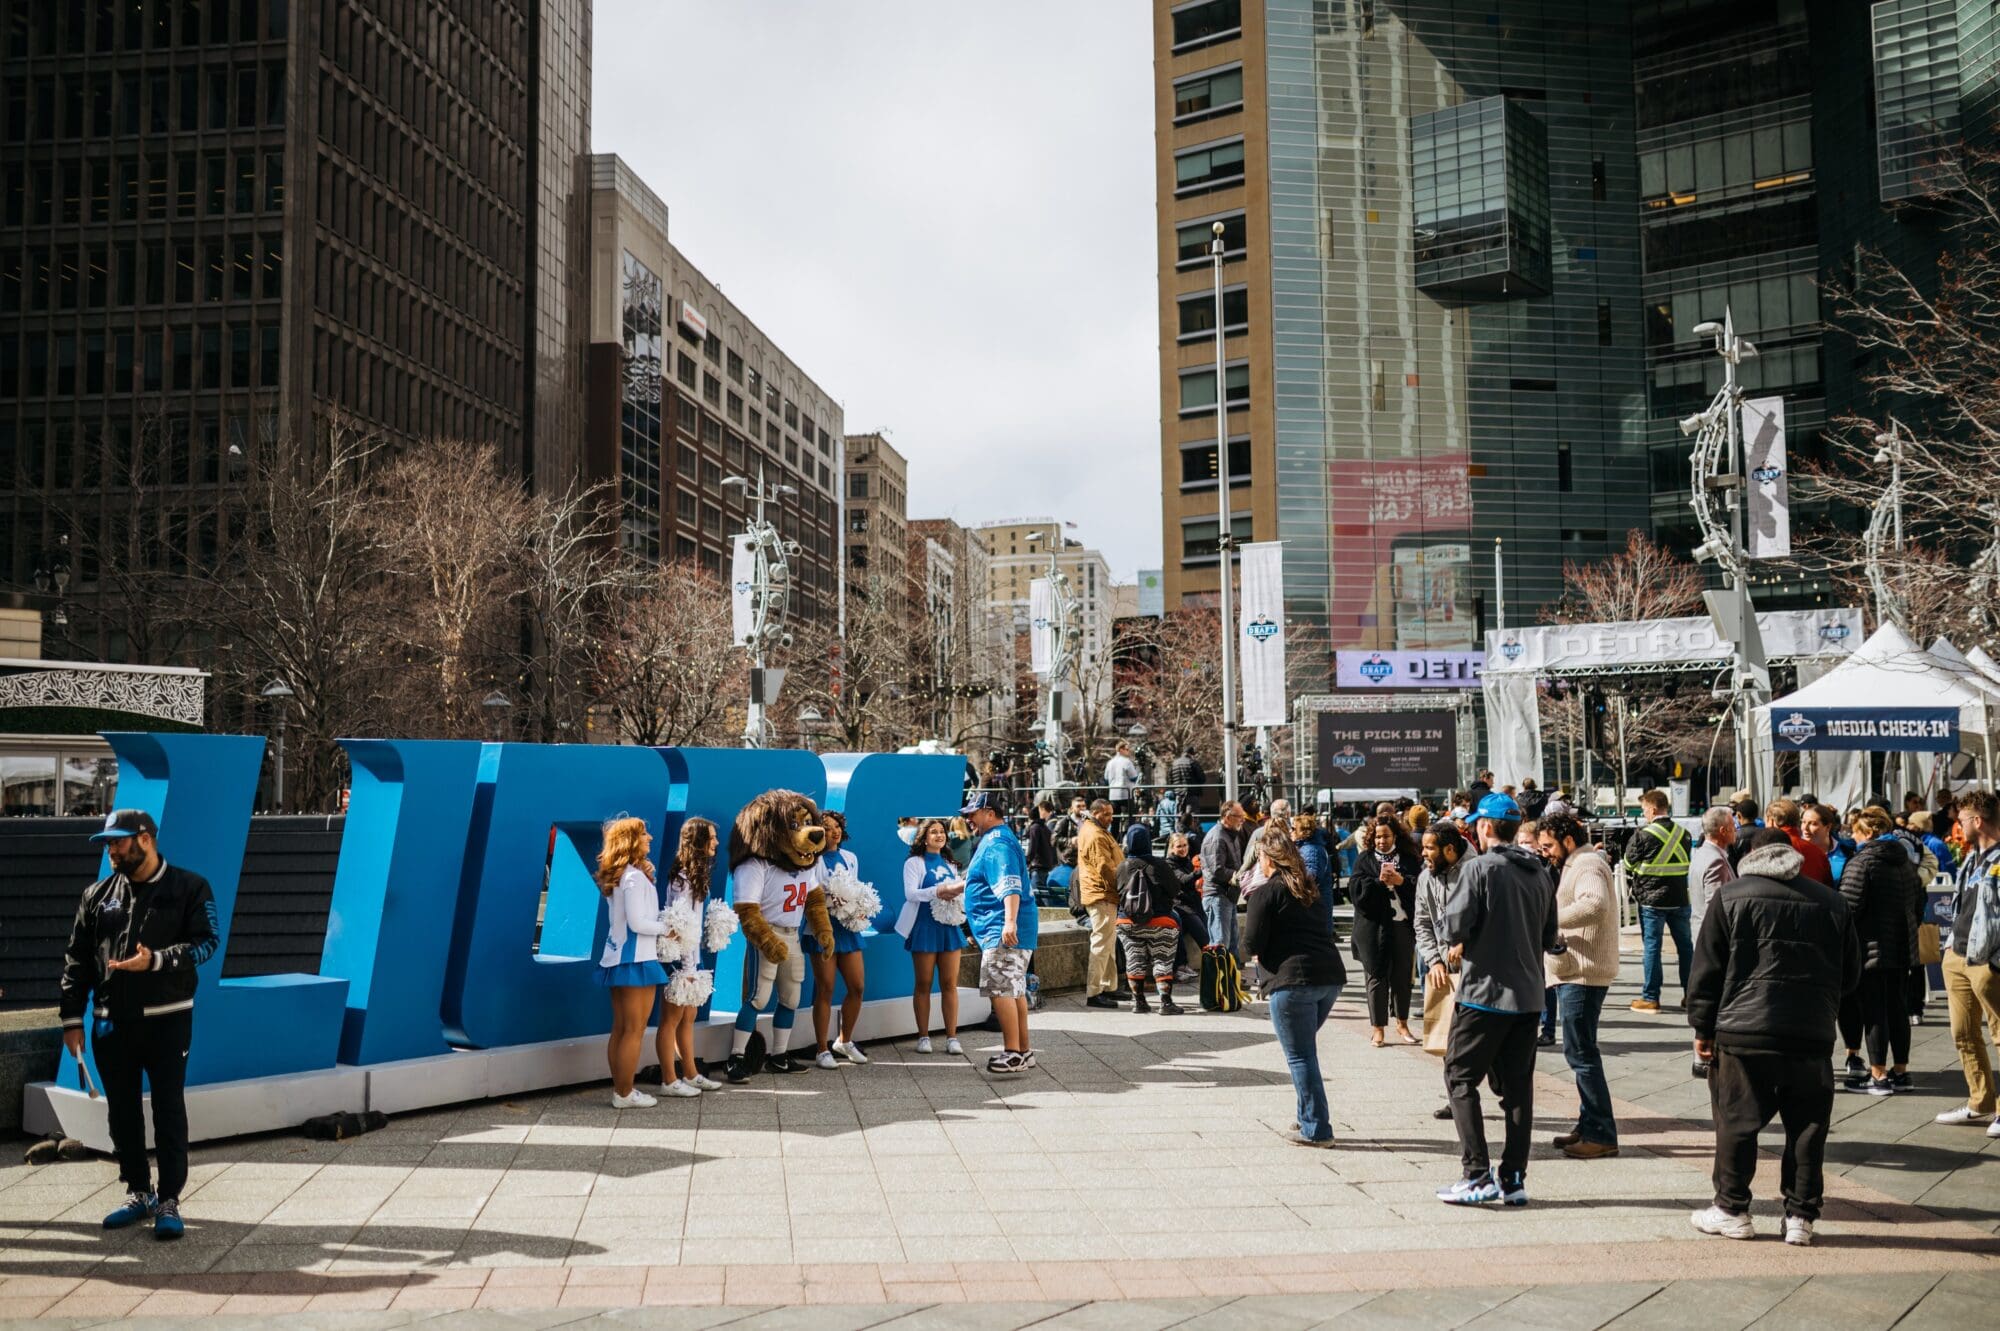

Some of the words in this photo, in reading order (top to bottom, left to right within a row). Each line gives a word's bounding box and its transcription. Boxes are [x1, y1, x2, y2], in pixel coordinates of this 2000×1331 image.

[1560, 624, 1770, 658] DETRO
[1362, 667, 1391, 675] DRAFT
[1407, 658, 1485, 680] DETR
[1333, 730, 1361, 740] THE
[1364, 730, 1401, 740] PICK
[1404, 730, 1422, 739] IS
[1425, 729, 1443, 739] IN
[1827, 720, 1877, 737] MEDIA
[1880, 720, 1950, 738] CHECK-IN
[1335, 757, 1363, 766] DRAFT
[783, 881, 807, 913] 24
